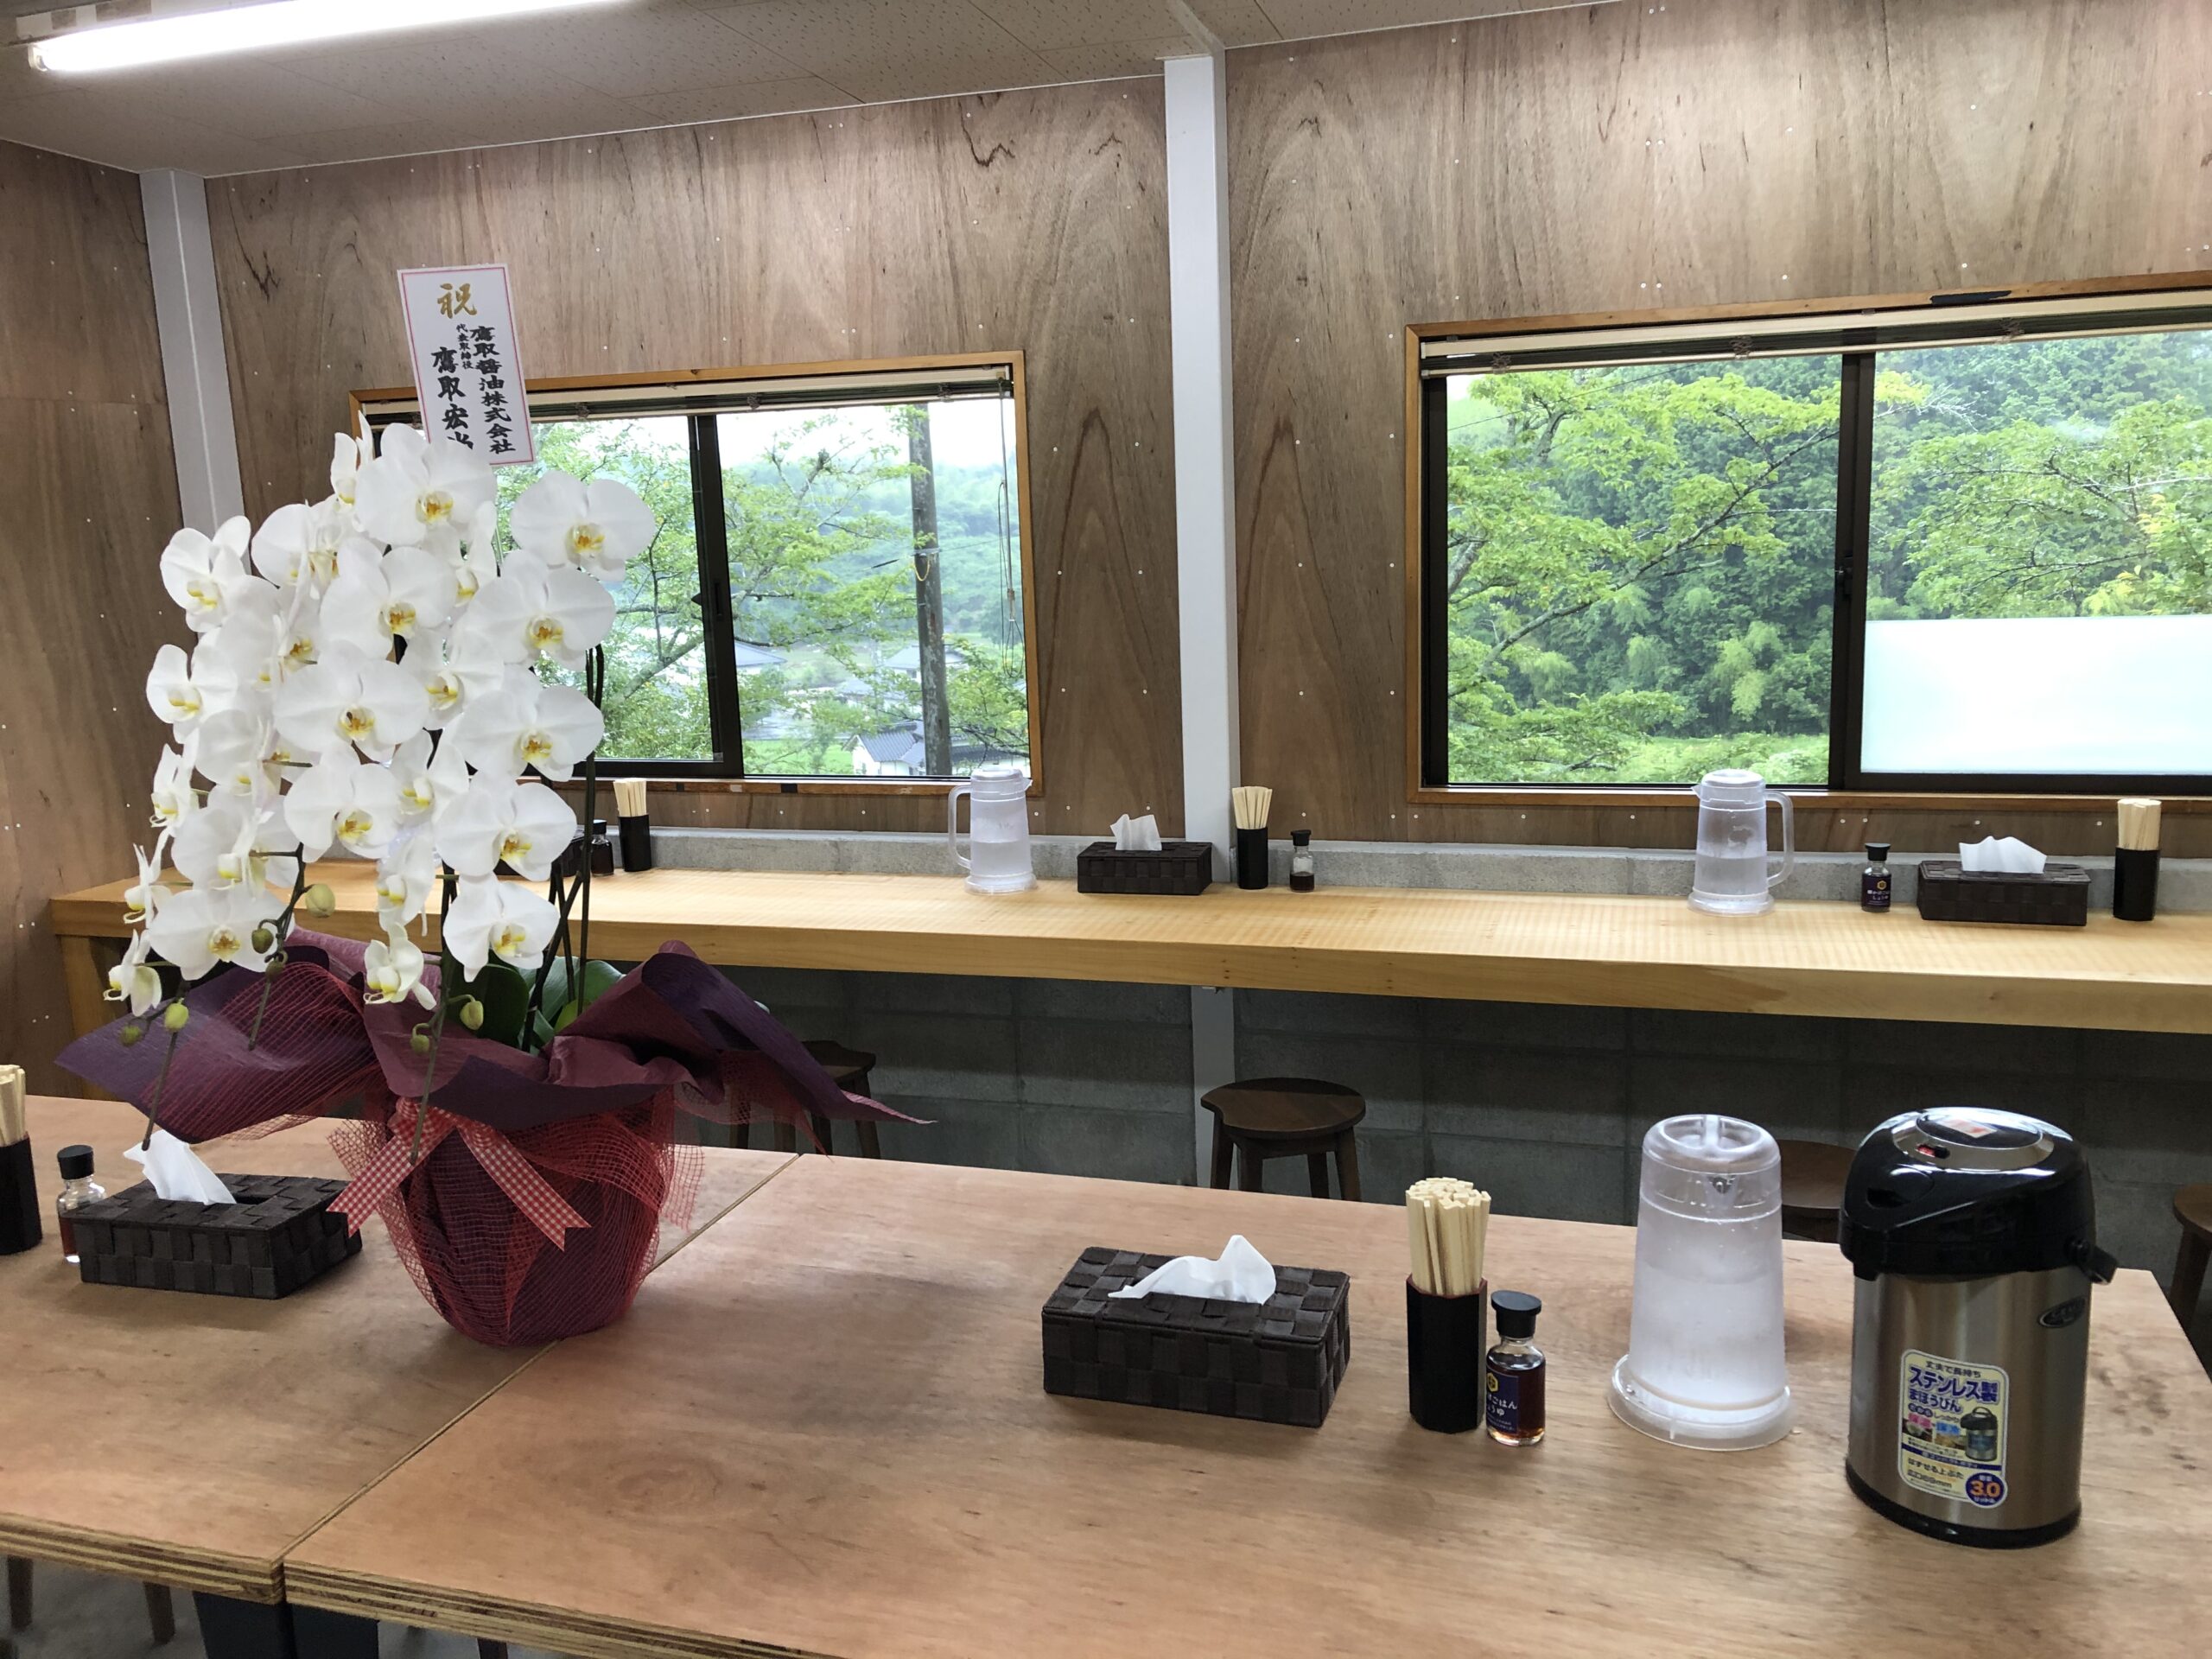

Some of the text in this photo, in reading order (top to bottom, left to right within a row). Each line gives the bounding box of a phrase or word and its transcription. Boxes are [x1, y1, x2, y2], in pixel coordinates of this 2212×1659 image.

[437, 283, 477, 319] 祝
[469, 326, 517, 454] 鷹取醤油株式会社
[1910, 1366, 1998, 1402] ステンレス製
[1910, 1389, 1961, 1412] まほうびん
